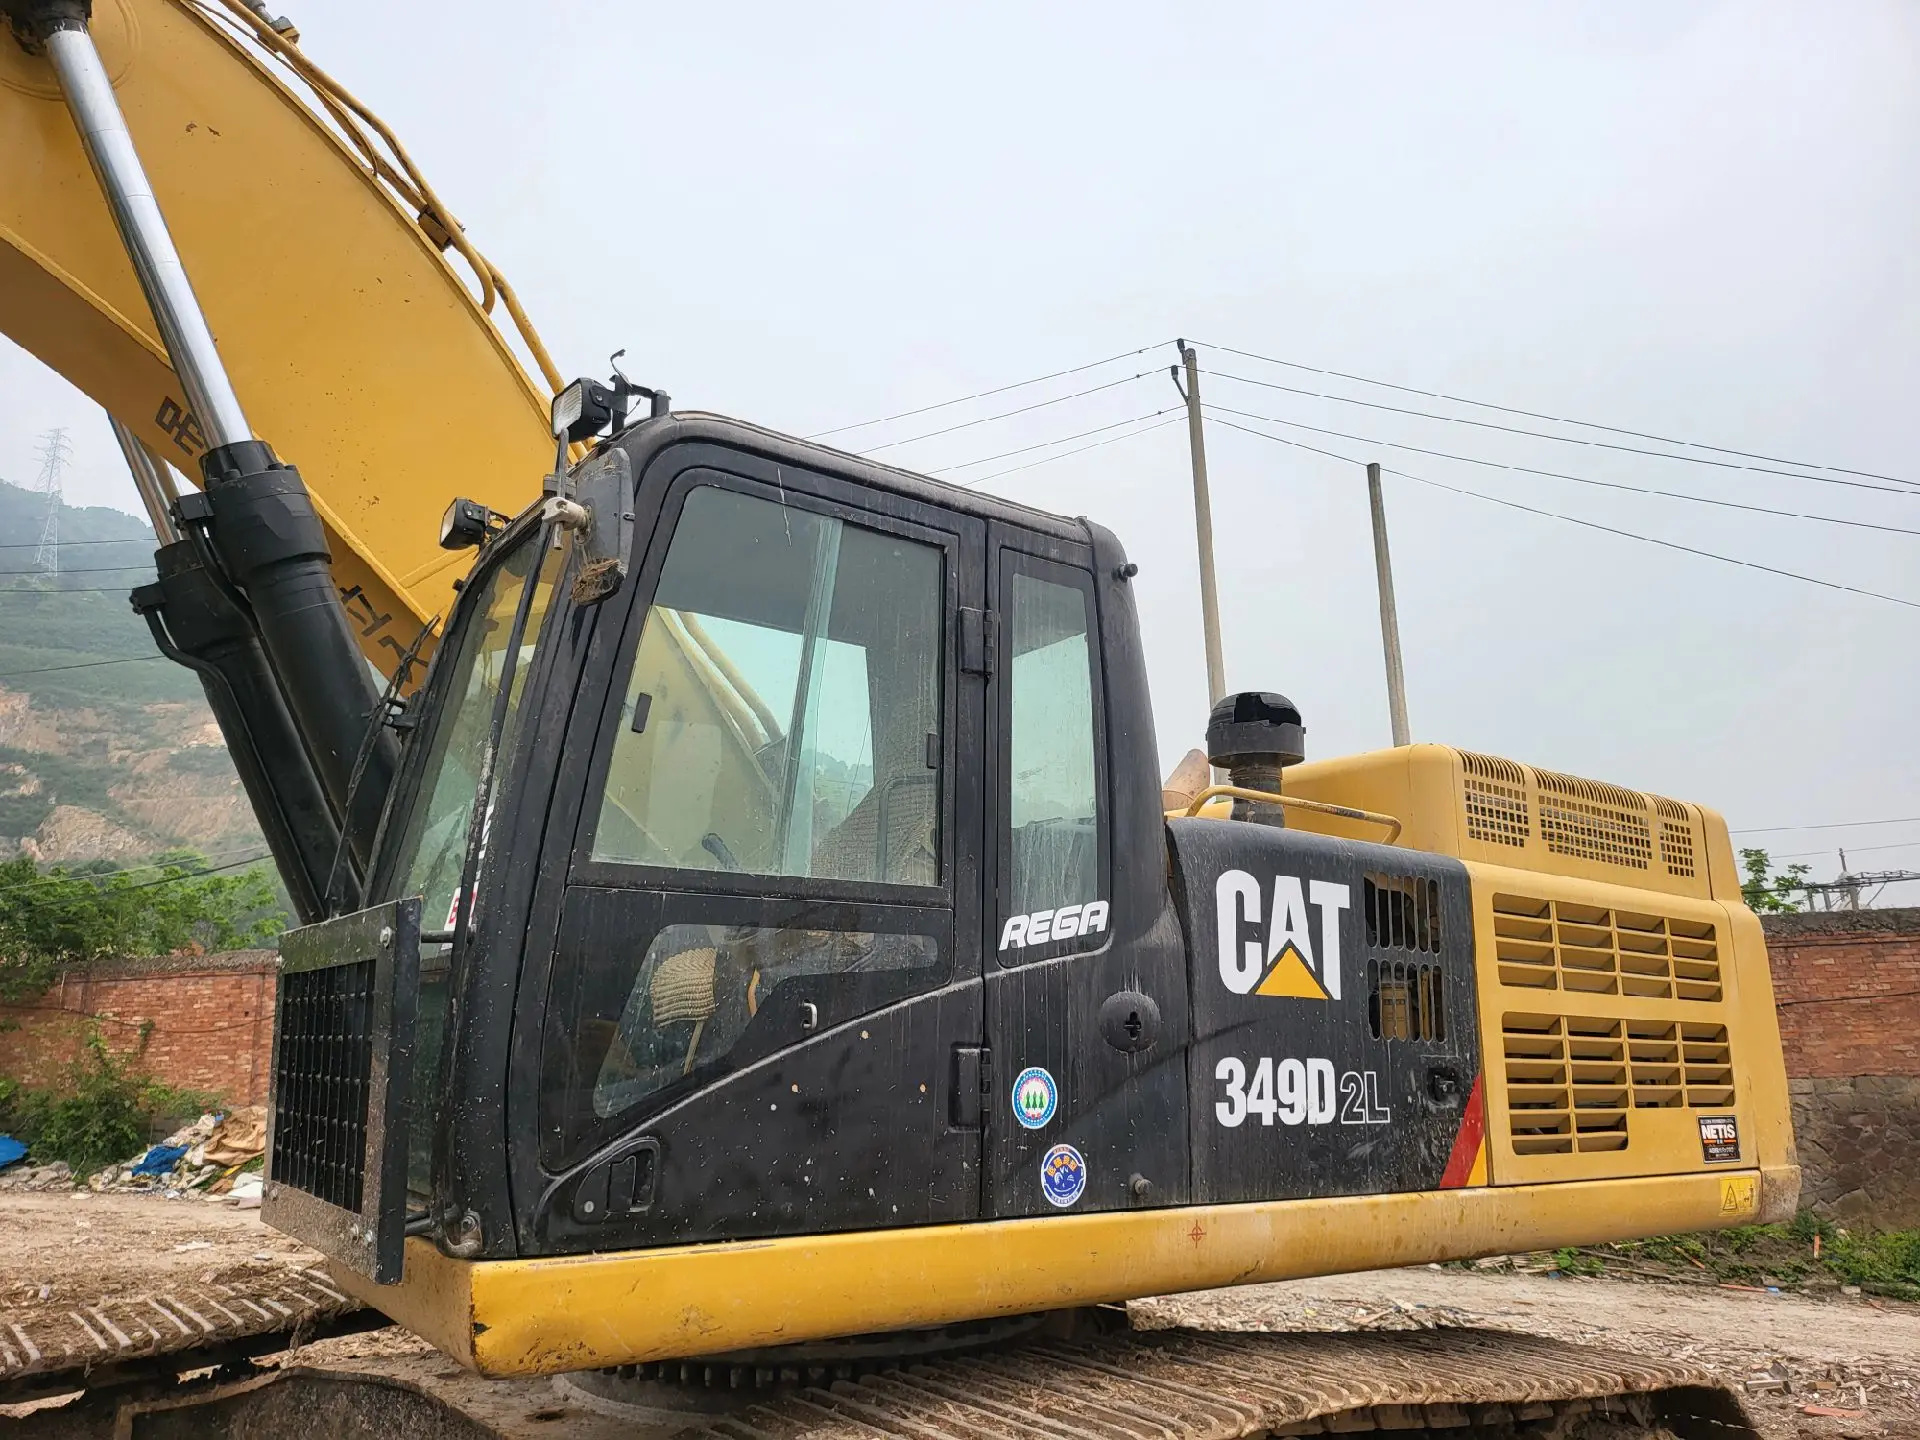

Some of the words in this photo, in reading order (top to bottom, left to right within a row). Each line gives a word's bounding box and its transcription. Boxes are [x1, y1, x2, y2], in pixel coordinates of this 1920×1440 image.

[998, 900, 1110, 951] REGA
[1216, 870, 1350, 1000] CAT
[1215, 1056, 1337, 1128] 349D
[1339, 1070, 1391, 1125] 2L
[1701, 1124, 1735, 1139] NETIS
